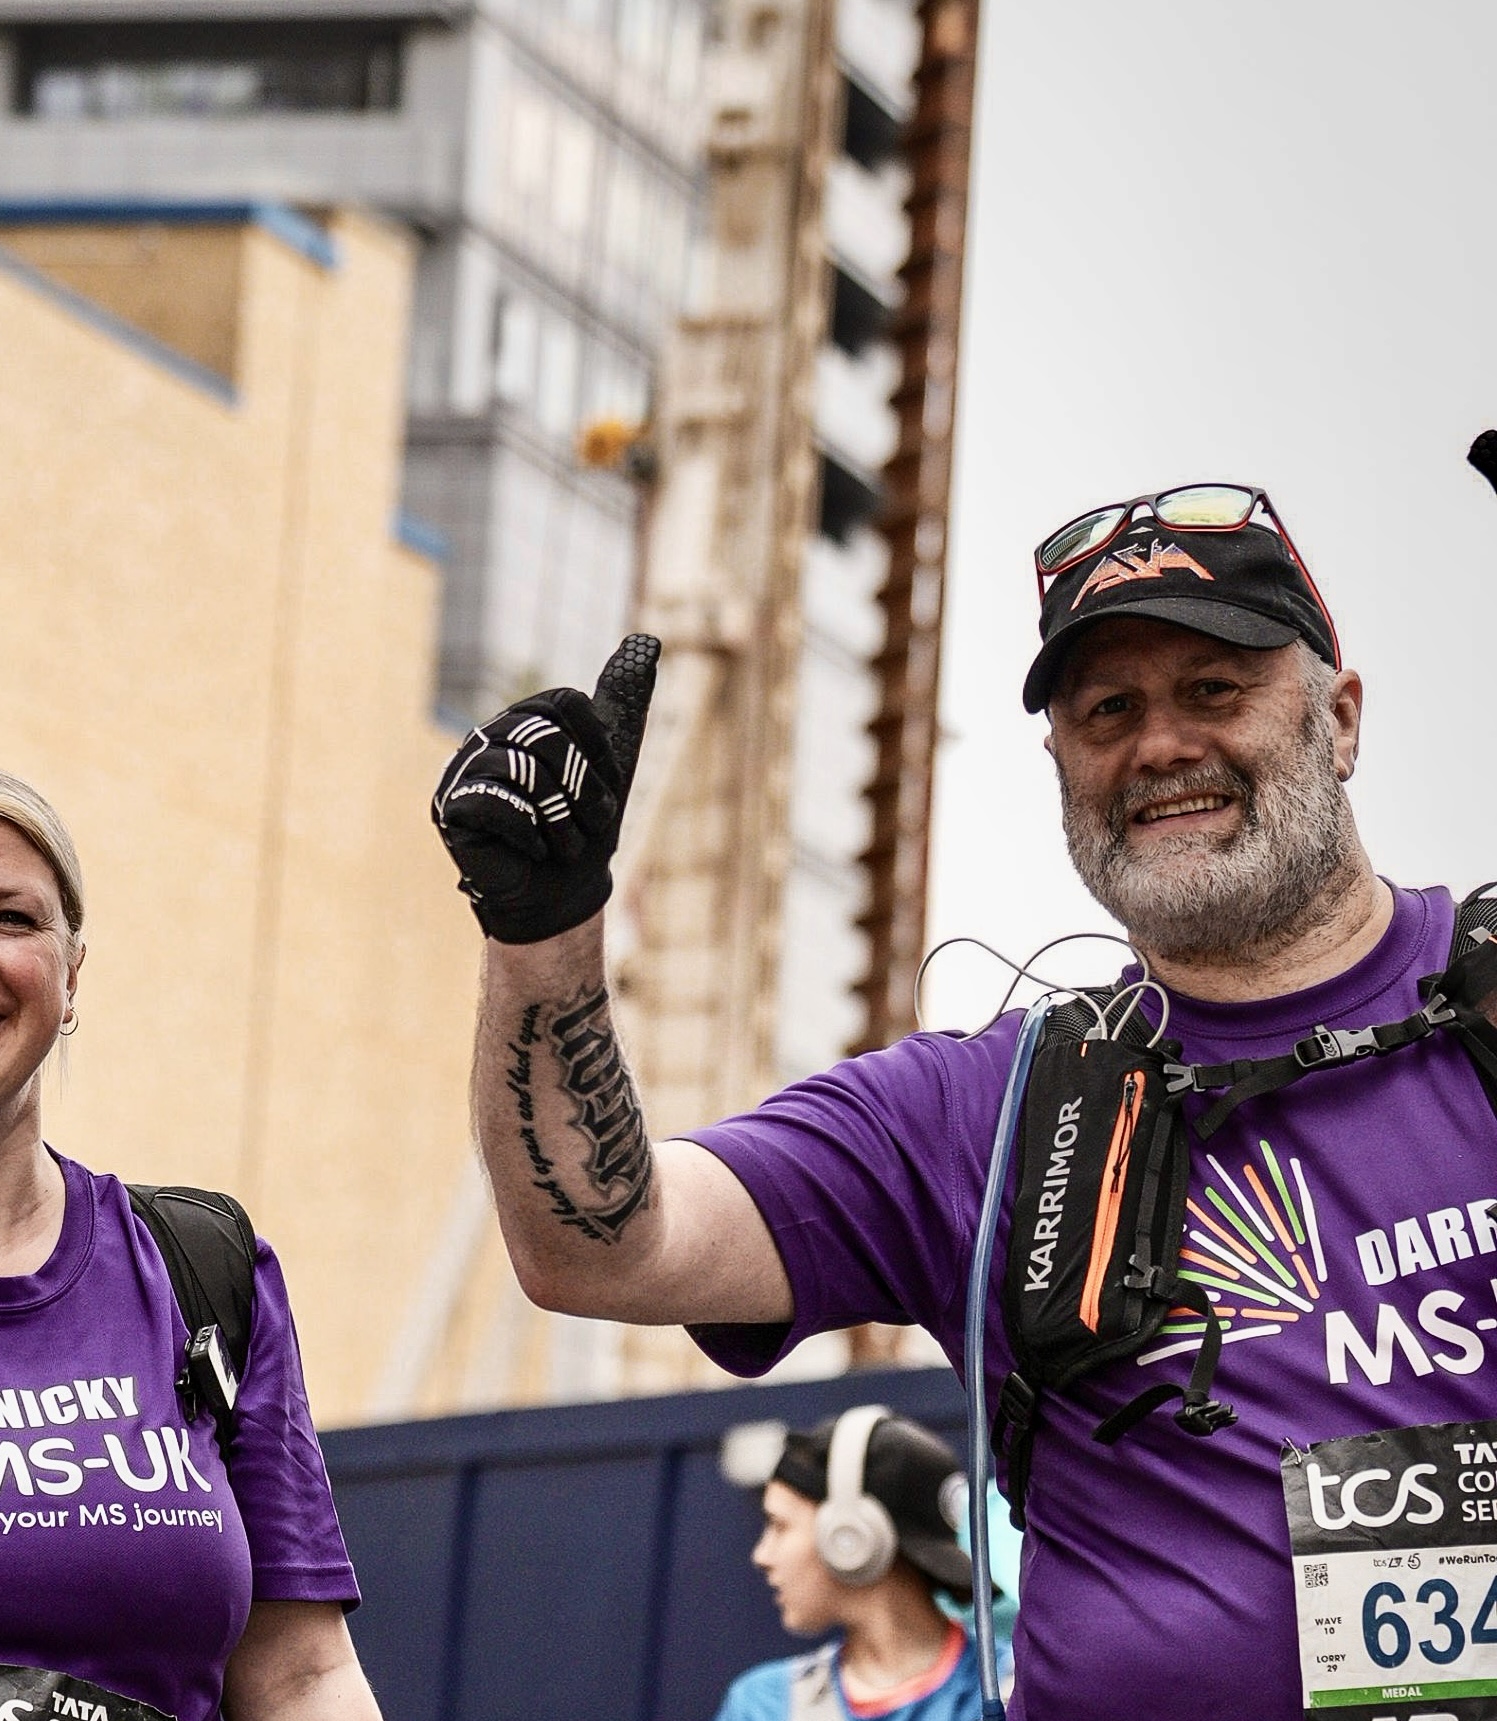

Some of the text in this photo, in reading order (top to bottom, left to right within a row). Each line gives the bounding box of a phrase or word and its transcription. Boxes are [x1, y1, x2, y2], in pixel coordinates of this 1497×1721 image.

[506, 1081, 533, 1121] and
[520, 1127, 553, 1175] again
[1024, 1096, 1083, 1292] KARRIMOR
[1325, 1278, 1497, 1386] MS-
[1306, 1462, 1445, 1530] tcs
[79, 1503, 127, 1528] MS
[132, 1501, 223, 1534] journey
[1314, 1616, 1342, 1626] WAVE
[1324, 1627, 1335, 1635] 10
[1316, 1654, 1346, 1663] LORRY
[1327, 1664, 1338, 1672] 29
[1382, 1686, 1423, 1699] MEDAL
